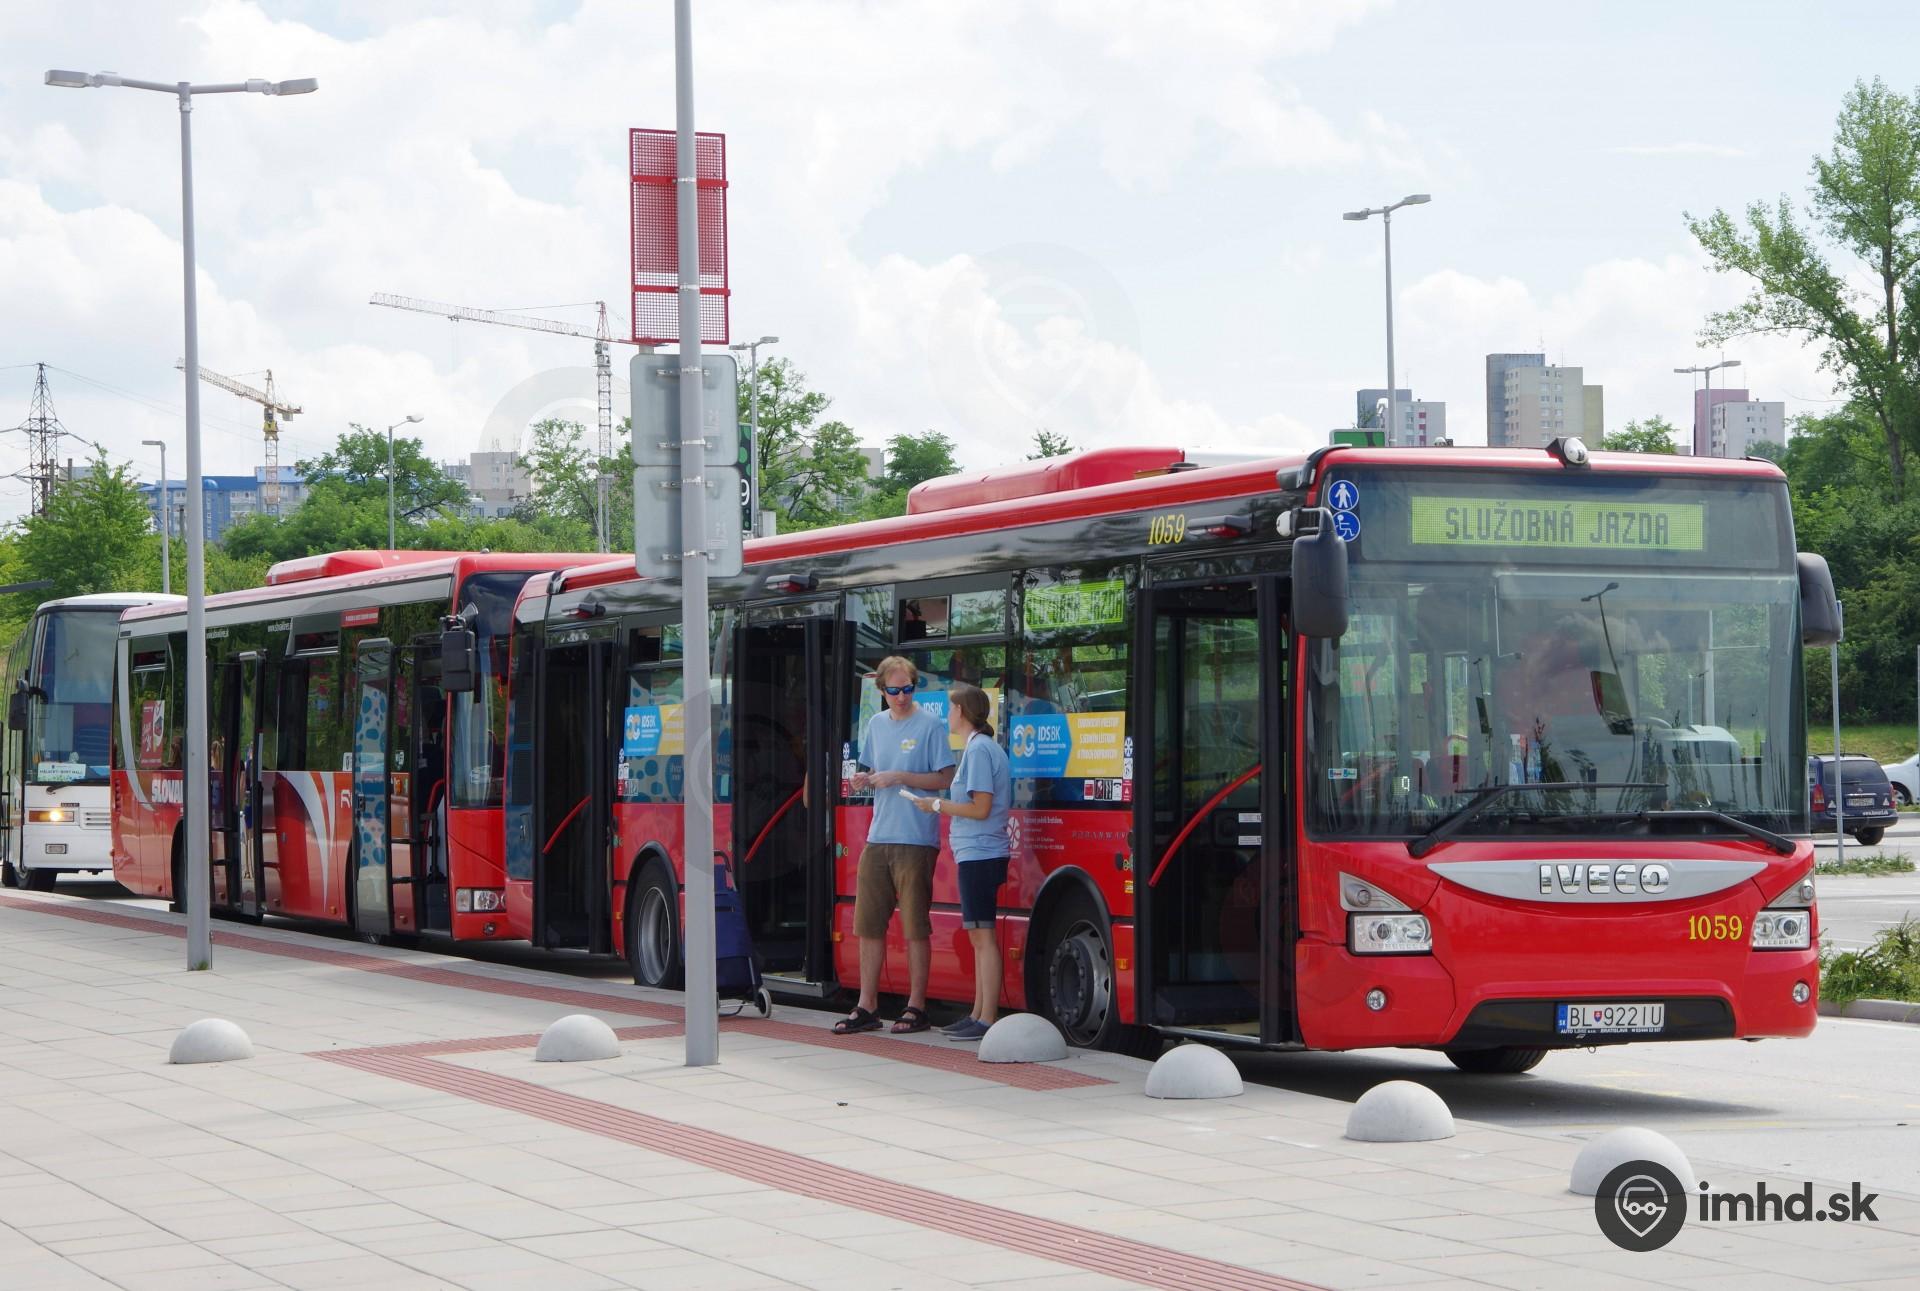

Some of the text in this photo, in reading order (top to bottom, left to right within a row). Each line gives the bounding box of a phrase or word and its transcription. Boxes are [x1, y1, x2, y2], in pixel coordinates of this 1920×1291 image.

[1148, 513, 1185, 545] 1059
[1445, 502, 1669, 545] SLUŽOBNÁ JAZDA
[1539, 864, 1670, 894] IVECO
[1688, 914, 1743, 941] 1059
[1569, 1007, 1592, 1027] BL
